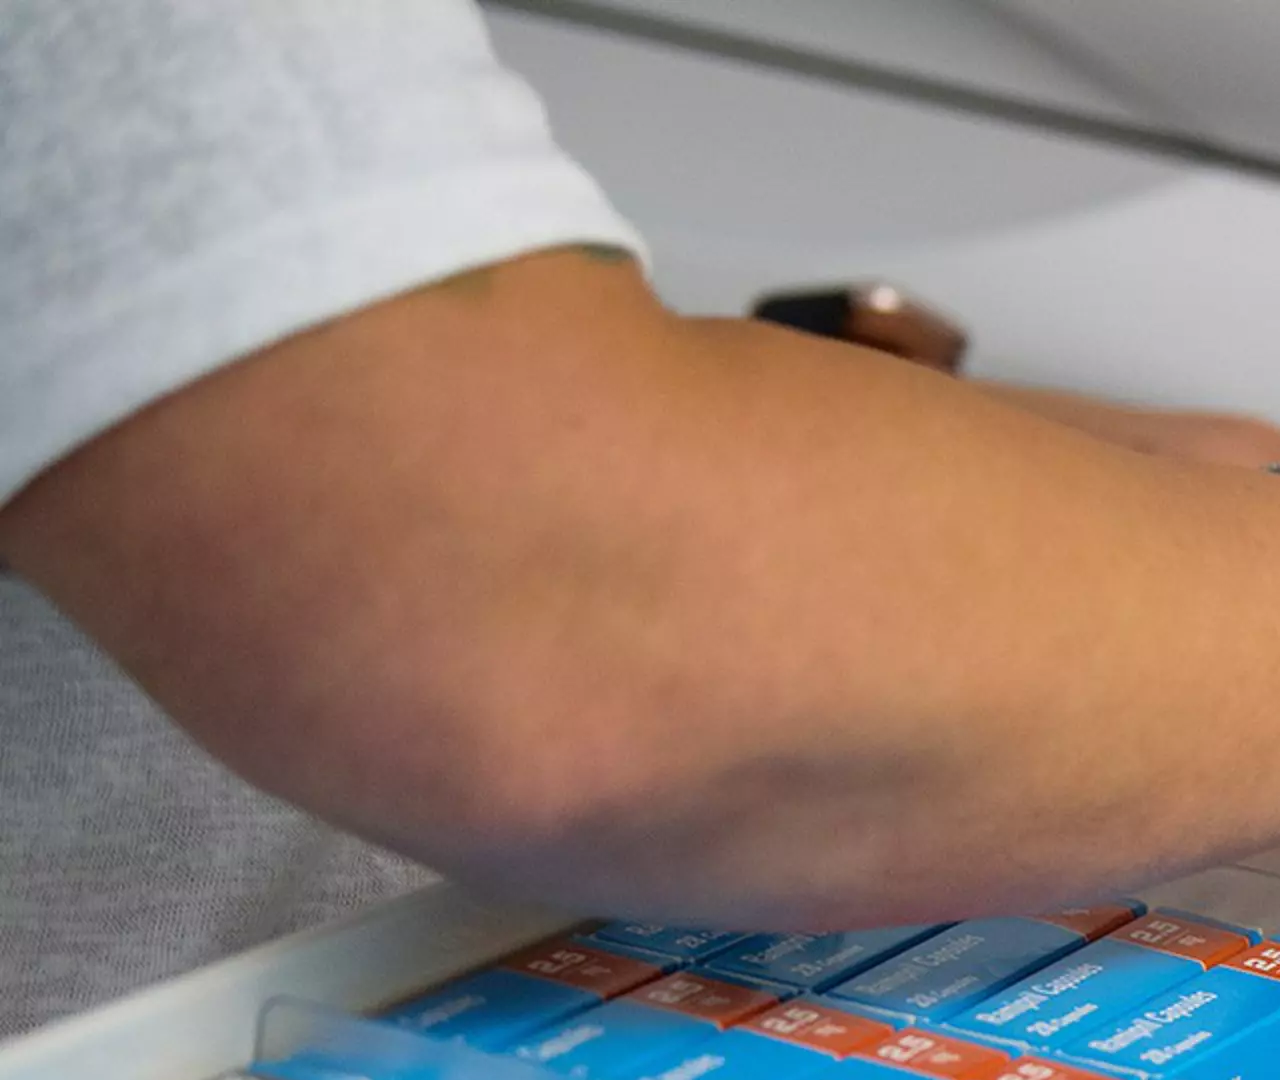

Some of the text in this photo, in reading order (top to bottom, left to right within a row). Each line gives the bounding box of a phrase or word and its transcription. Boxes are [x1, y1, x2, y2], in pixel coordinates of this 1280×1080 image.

[1129, 920, 1181, 943] 2.5
[1030, 963, 1103, 995] Capsules
[1144, 990, 1218, 1023] Capsules
[761, 1008, 819, 1033] 2.5
[877, 1035, 934, 1062] 2.5
